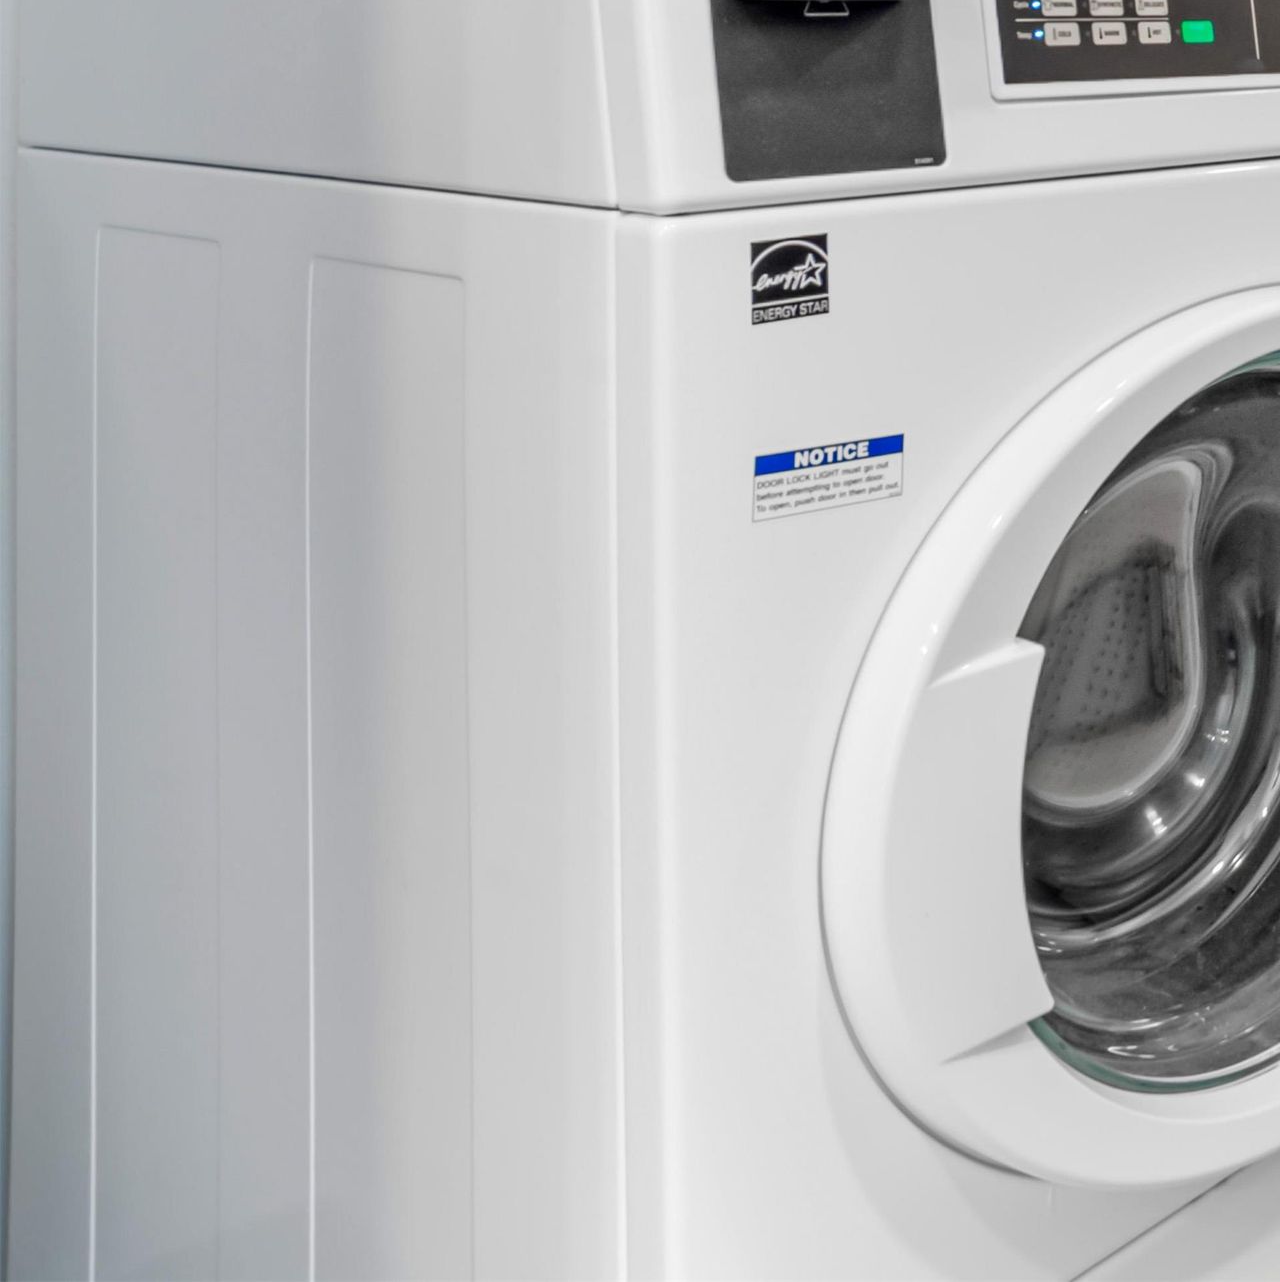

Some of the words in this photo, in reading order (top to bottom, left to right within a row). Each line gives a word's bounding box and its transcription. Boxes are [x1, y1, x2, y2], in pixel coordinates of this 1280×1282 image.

[753, 304, 798, 323] ENERGY
[800, 300, 829, 316] STAR
[794, 441, 869, 468] NOTICE
[757, 477, 785, 490] DOOR
[786, 473, 811, 485] LOCK
[813, 468, 840, 480] LIGHT
[786, 483, 830, 496] attempting
